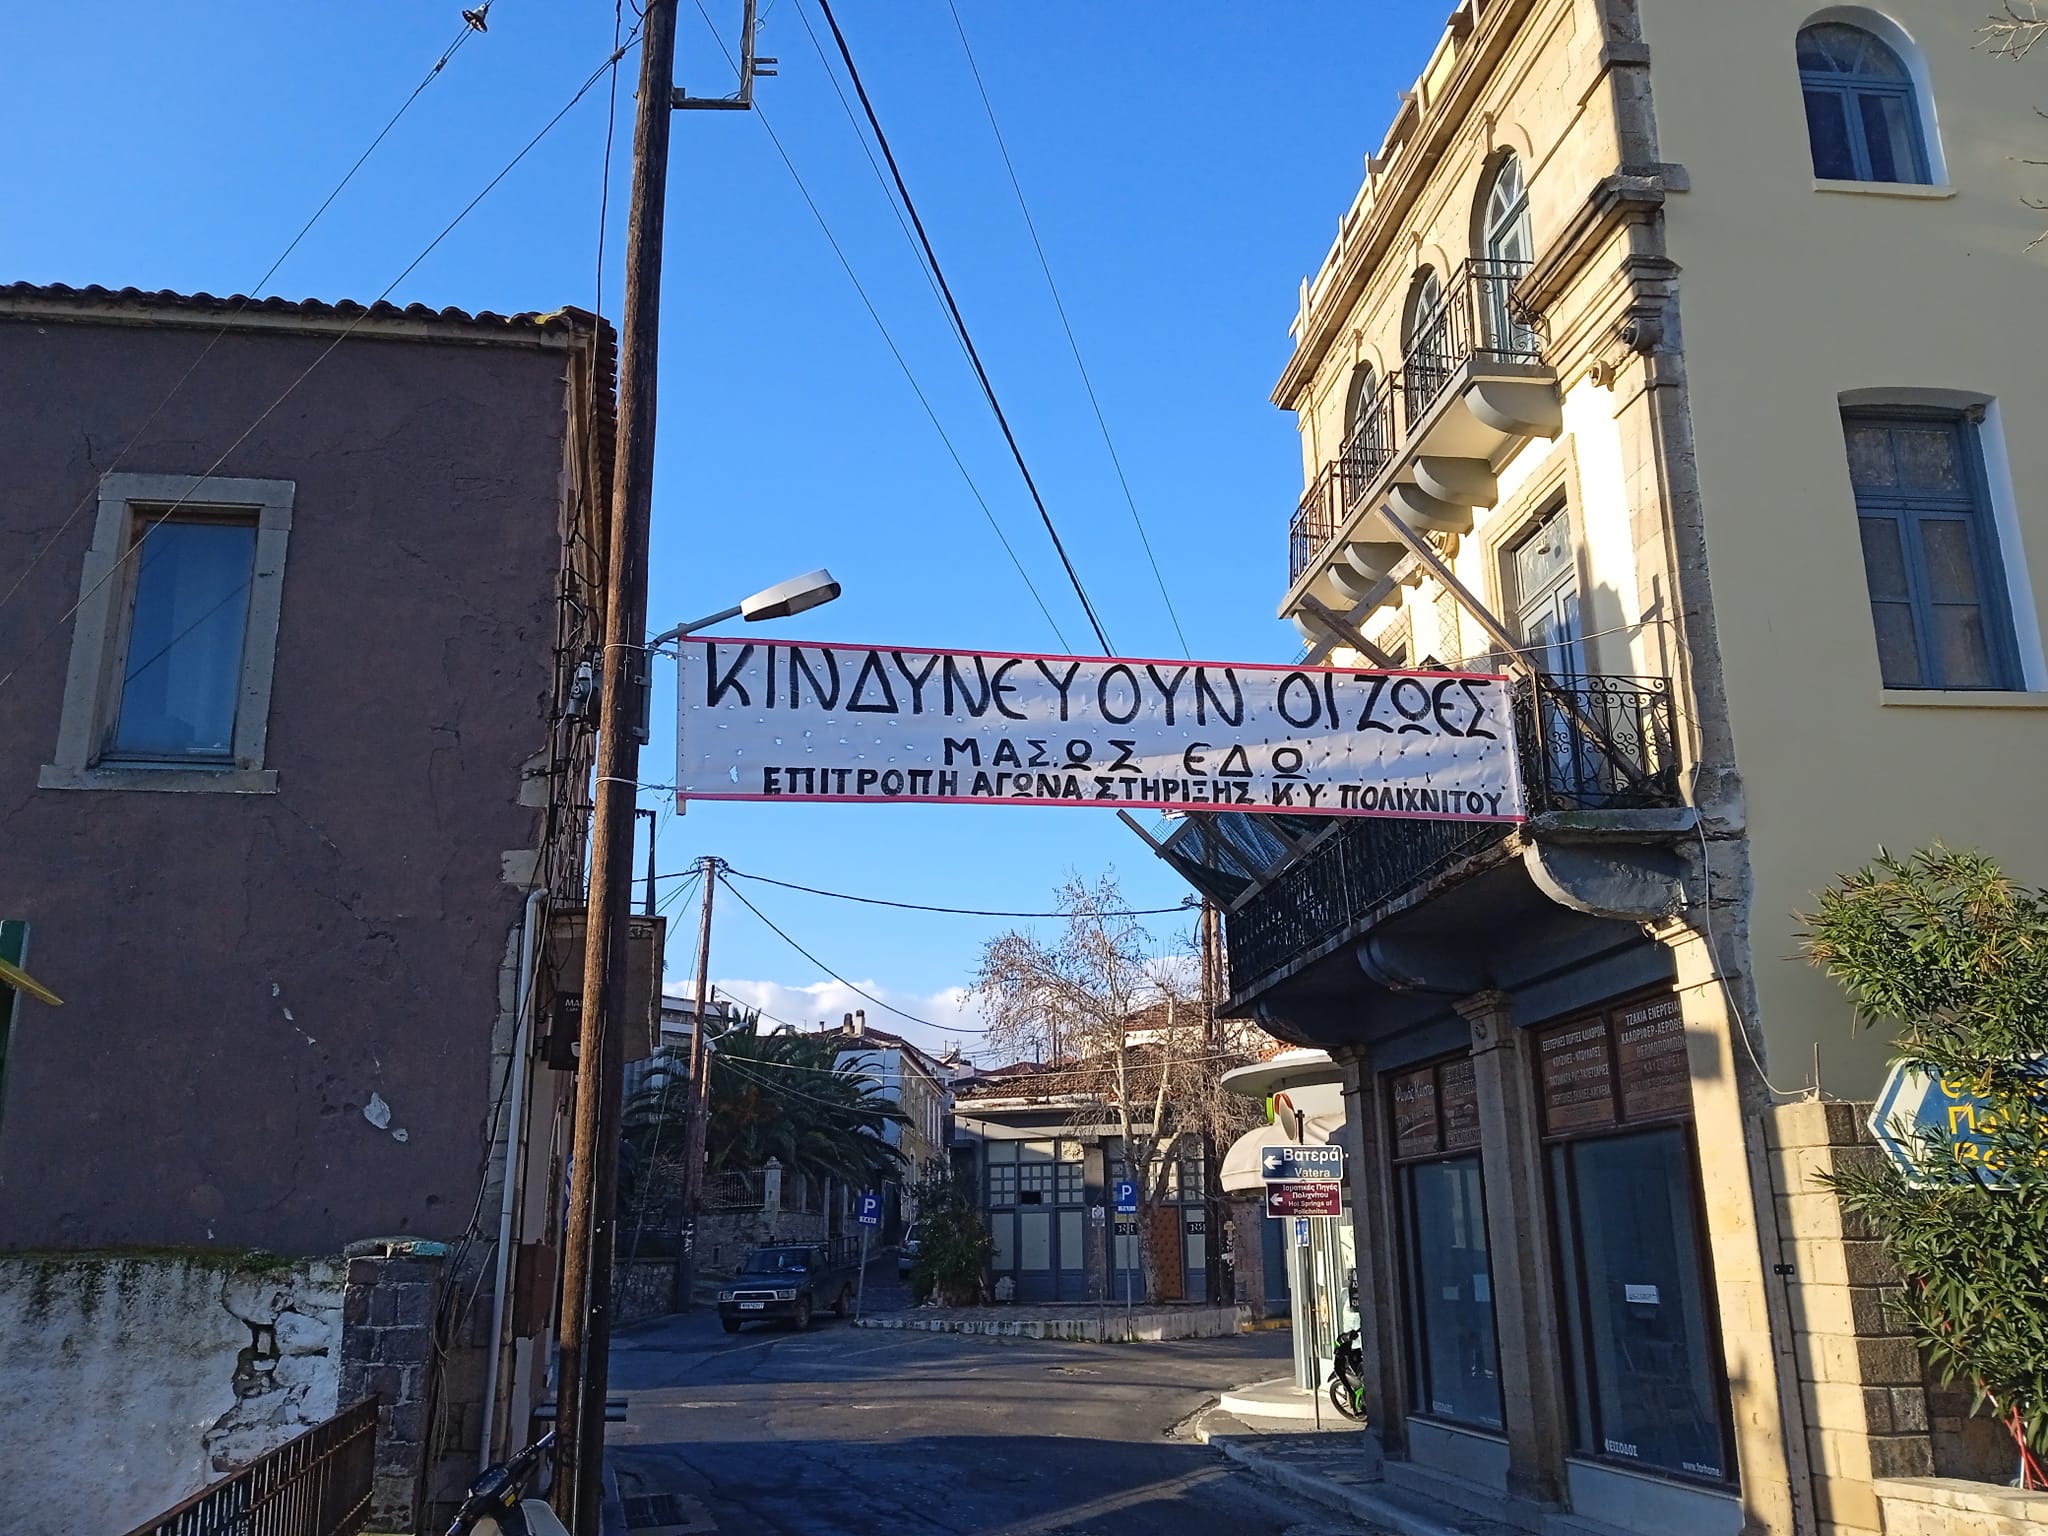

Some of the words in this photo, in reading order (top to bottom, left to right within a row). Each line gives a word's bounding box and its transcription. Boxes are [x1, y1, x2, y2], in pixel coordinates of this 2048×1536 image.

[706, 642, 1245, 727] ΚΙΝΔΥΝΕΥΟΥΝ
[1277, 672, 1340, 730] ΟΙ
[1354, 674, 1498, 740] ΖΩΕΣ
[1183, 742, 1308, 780] ΕΔΩ
[763, 766, 958, 796] ΕΠΙΤΡΟΠΗ
[971, 771, 1083, 801] ΑΓΩΝΑ
[1093, 775, 1257, 806] ΣΤΗΡΙΞΗΣ
[1338, 784, 1503, 817] ΠΟΛΙΧΝΙΤΟΥ
[1626, 1009, 1648, 1026] ΤΖΑΚΙΑ
[1283, 1147, 1340, 1164] Βατερά
[1294, 1167, 1331, 1178] Vatera
[1609, 1439, 1638, 1457] ΕΙΣΟΔΟΣ
